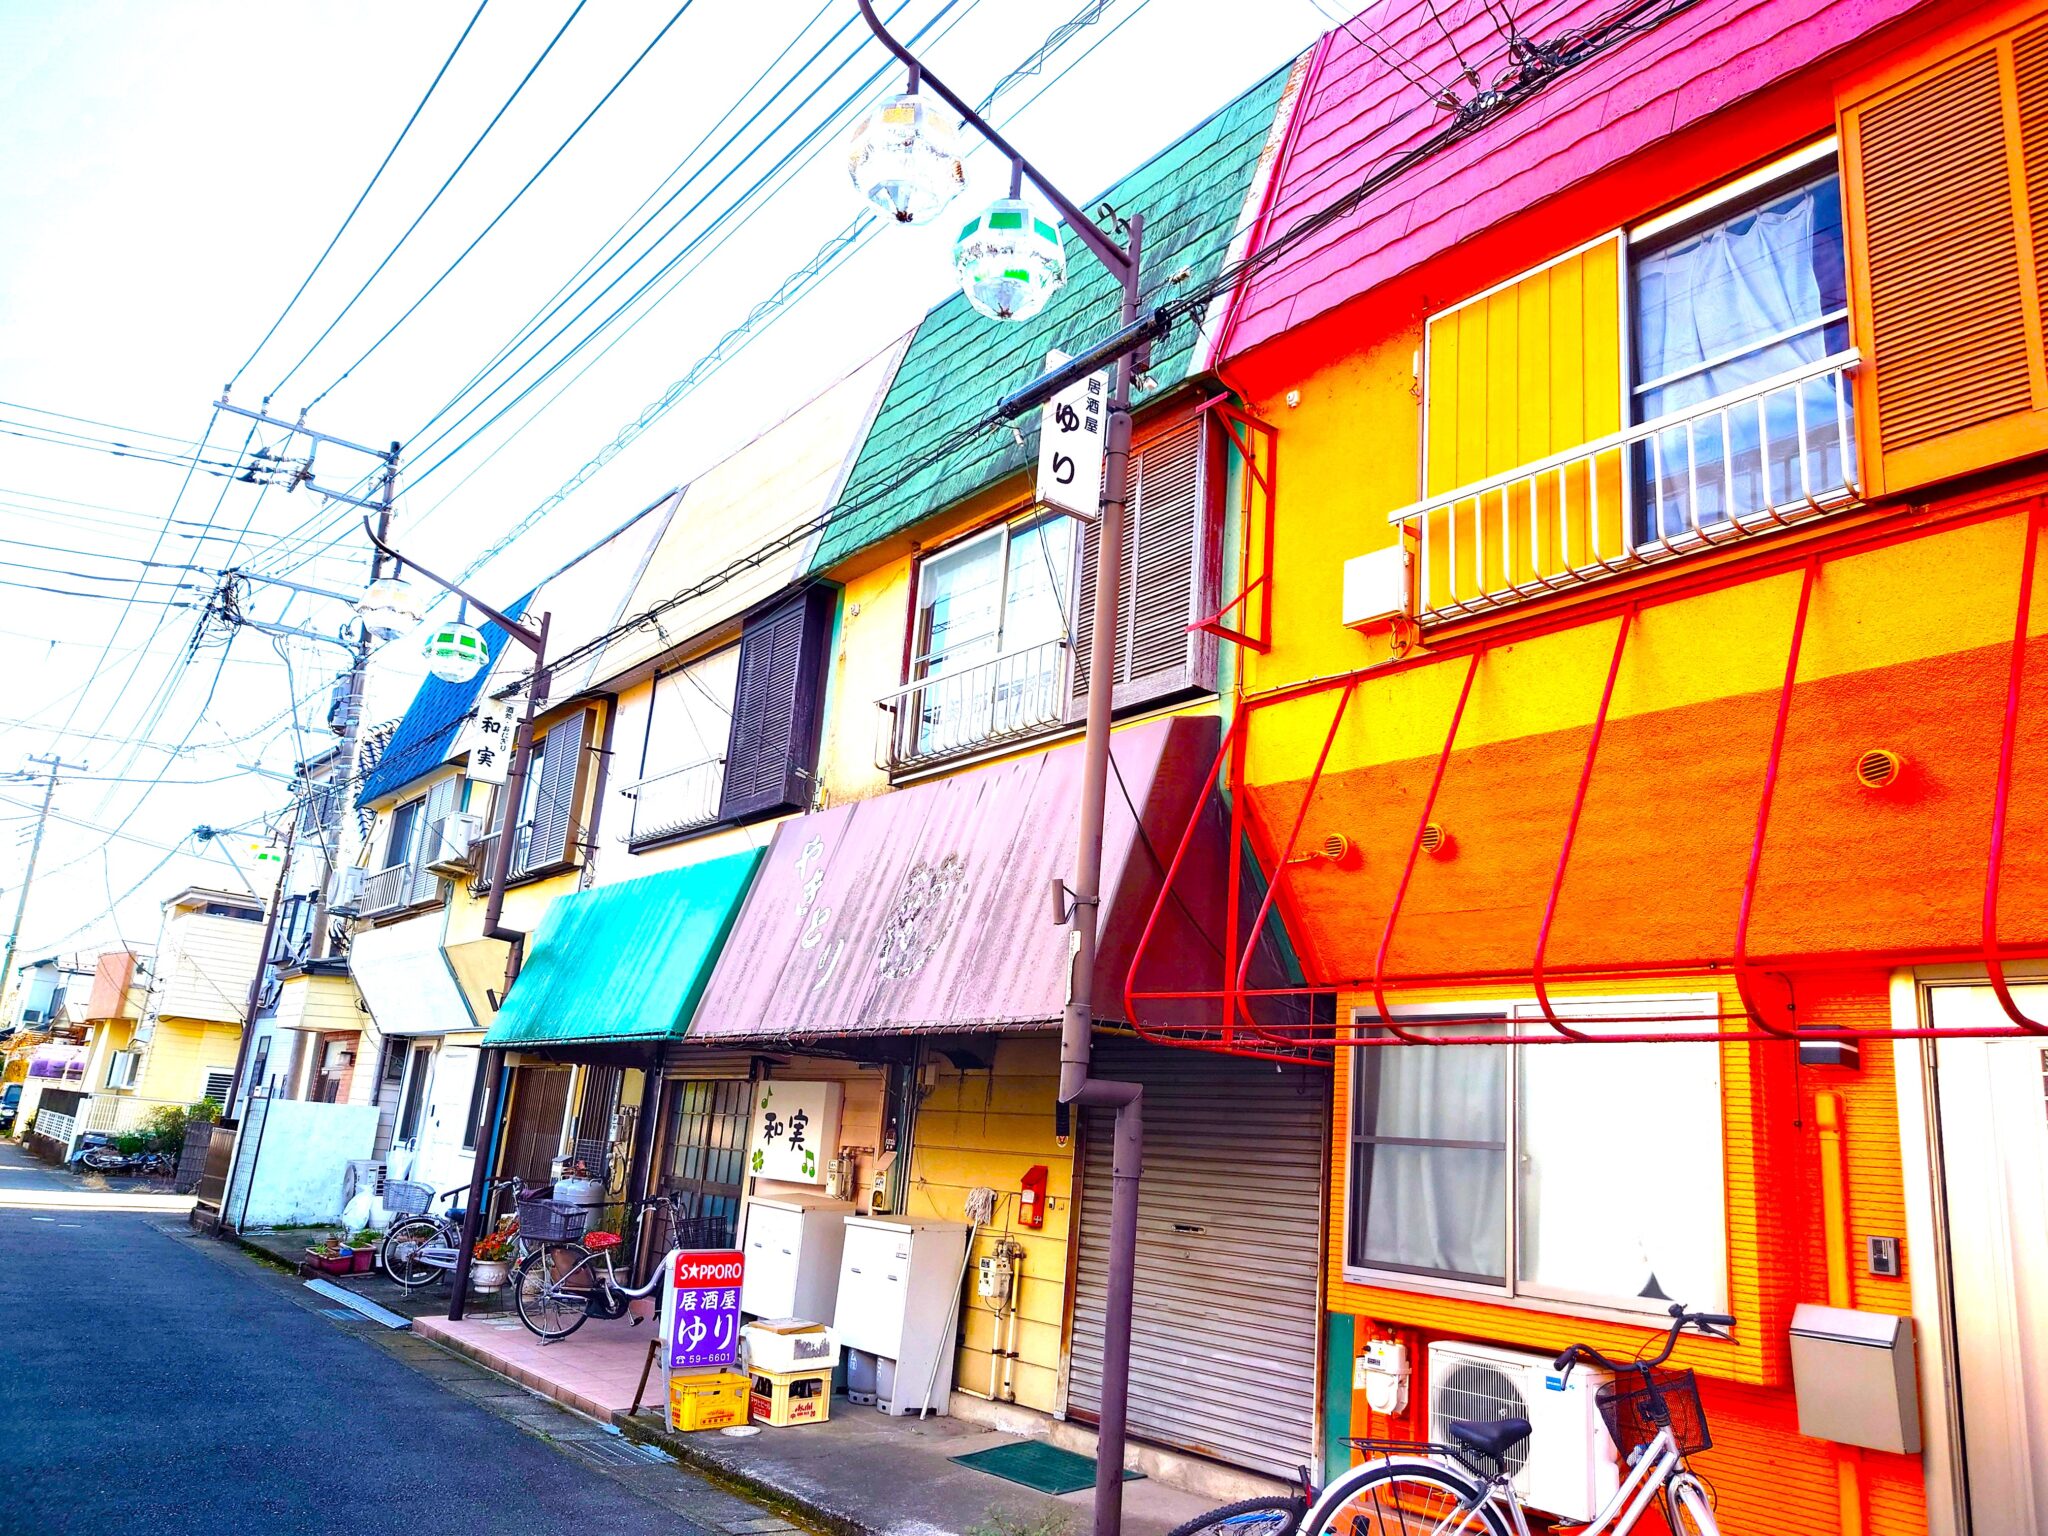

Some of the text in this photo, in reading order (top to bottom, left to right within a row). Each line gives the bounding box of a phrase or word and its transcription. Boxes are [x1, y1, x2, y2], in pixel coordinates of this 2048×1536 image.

[1084, 377, 1102, 435] 居酒屋
[1053, 402, 1080, 485] ゆり
[477, 716, 501, 768] 和実
[763, 1108, 809, 1152] 和実
[679, 1290, 736, 1312] 居酒屋
[678, 1314, 733, 1352] ゆり
[689, 1353, 730, 1363] 59-6601
